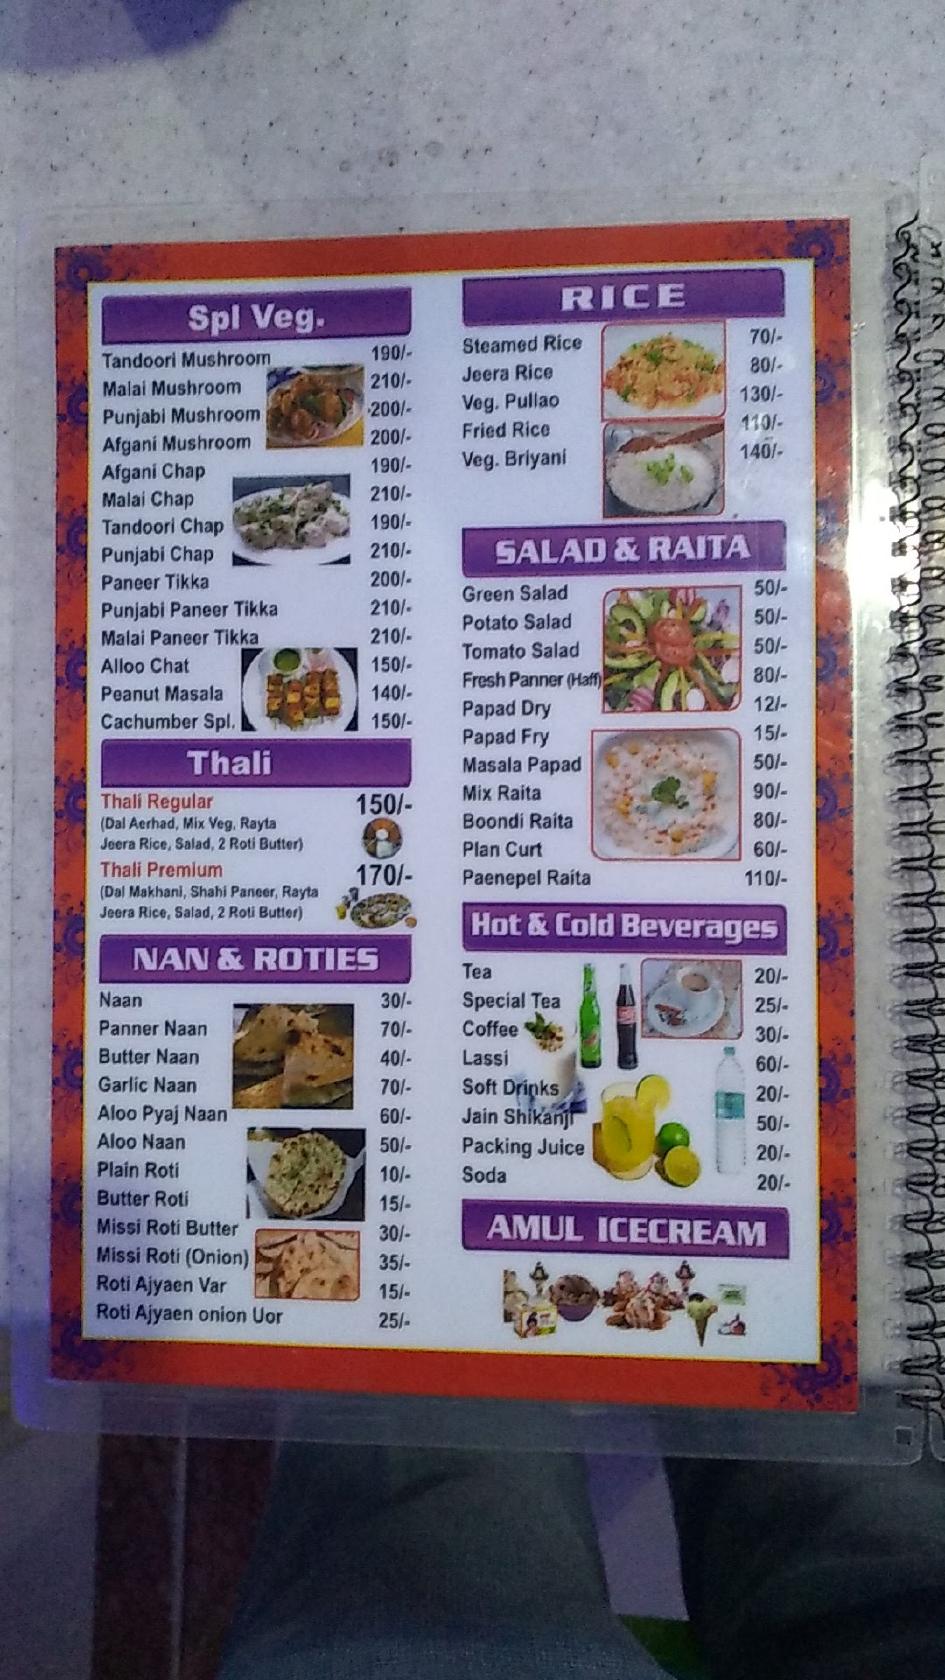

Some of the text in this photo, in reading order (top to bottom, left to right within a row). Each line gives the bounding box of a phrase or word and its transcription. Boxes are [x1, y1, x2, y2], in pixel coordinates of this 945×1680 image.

[561, 284, 686, 311] RICE
[189, 303, 325, 336] Spl Veg.
[463, 335, 582, 354] Steamed Rice
[751, 329, 783, 344] 70/-
[103, 351, 271, 368] Tandoori Mushroom
[372, 345, 412, 360] 190/-
[463, 364, 553, 382] Jeera Rice
[103, 380, 241, 396] Malai Mushroom
[740, 386, 783, 401] 130/-
[371, 402, 412, 417] 200/-
[463, 395, 499, 414] Veg.
[103, 408, 260, 428] Punjabi Mushroom
[463, 421, 550, 439] Fried Rice
[740, 444, 783, 459] 140/-
[371, 458, 412, 473] 190/-
[463, 449, 566, 471] Veg. Briyani
[102, 463, 205, 484] Afgani Chap
[103, 492, 194, 510] Malai Chap
[102, 518, 223, 536] Tandoori Chap
[372, 515, 412, 530] 190/-
[496, 534, 751, 565] SALAD & RAITA
[102, 574, 209, 590] Paneer Tikka
[371, 571, 412, 587] 200/-
[463, 585, 568, 602] Green Salad
[102, 601, 278, 622] Punjabi Paneer Tikka
[755, 609, 787, 625] 50/-
[102, 629, 258, 646] Malai Paneer Tikka
[371, 629, 412, 644] 210/-
[463, 642, 579, 659] Tomato Salad
[101, 658, 189, 674] Alloo Chat
[463, 673, 505, 688] Fresh
[509, 671, 563, 687] Panner
[754, 667, 787, 683] 80/-
[102, 686, 223, 701] Peanut Masala
[372, 685, 412, 701] 140/-
[463, 701, 551, 720] Papad Dry
[101, 714, 235, 733] Cachumber Spl.
[755, 725, 787, 741] 15/-
[187, 750, 272, 775] Thali
[463, 757, 581, 776] Masala Papad
[463, 785, 541, 801] Mix Raita
[754, 783, 787, 799] 90/-
[101, 794, 213, 813] Thali Regular
[357, 794, 412, 814] 150/-
[101, 818, 125, 831] (Dal
[183, 818, 204, 829] Mix
[241, 818, 276, 832] Rayta
[463, 813, 573, 829] Boondi Raita
[101, 837, 303, 851] Jeera Rice, Salad, 2 Roti Butter)
[463, 842, 542, 857] Plan Curt
[754, 841, 787, 857] 60/-
[101, 862, 222, 878] Thali Premium
[357, 864, 412, 885] 170/-
[463, 870, 591, 889] Paenepel Raita
[471, 912, 778, 944] Hot & Cold Beverages
[134, 948, 378, 971] NAN & ROTIES
[463, 963, 492, 979] Tea
[755, 968, 788, 984] 20/-
[99, 993, 142, 1008] Naan
[381, 993, 412, 1008] 30/-
[463, 992, 560, 1012] Special Tea
[99, 1021, 207, 1036] Panner Naan
[463, 1021, 518, 1037] Coffee
[756, 1027, 789, 1042] 30/-
[99, 1049, 199, 1065] Butter Naan
[381, 1050, 412, 1065] 40/-
[463, 1050, 509, 1066] Lassi
[99, 1077, 196, 1093] Garlic Naan
[463, 1079, 559, 1097] Soft Drinks
[756, 1086, 789, 1102] 20/-
[98, 1105, 227, 1125] Aloo Pyaj Naan
[380, 1109, 411, 1124] 60/-
[462, 1108, 574, 1130] Jain Shikanji
[463, 1138, 585, 1158] Packing Juice
[757, 1145, 790, 1161] 20/-
[97, 1162, 179, 1178] Plain Roti
[380, 1167, 411, 1182] 10/-
[462, 1167, 506, 1184] Soda
[97, 1219, 238, 1236] Missi Roti Butter
[380, 1225, 410, 1240] 30/-
[487, 1214, 767, 1247] AMUL ICECREAM
[97, 1247, 249, 1269] Missi Roti (Onion)
[97, 1275, 130, 1292] Roti
[199, 1278, 227, 1293] Var
[380, 1284, 410, 1299] 15/-
[97, 1304, 130, 1320] Roti
[199, 1307, 246, 1323] onion
